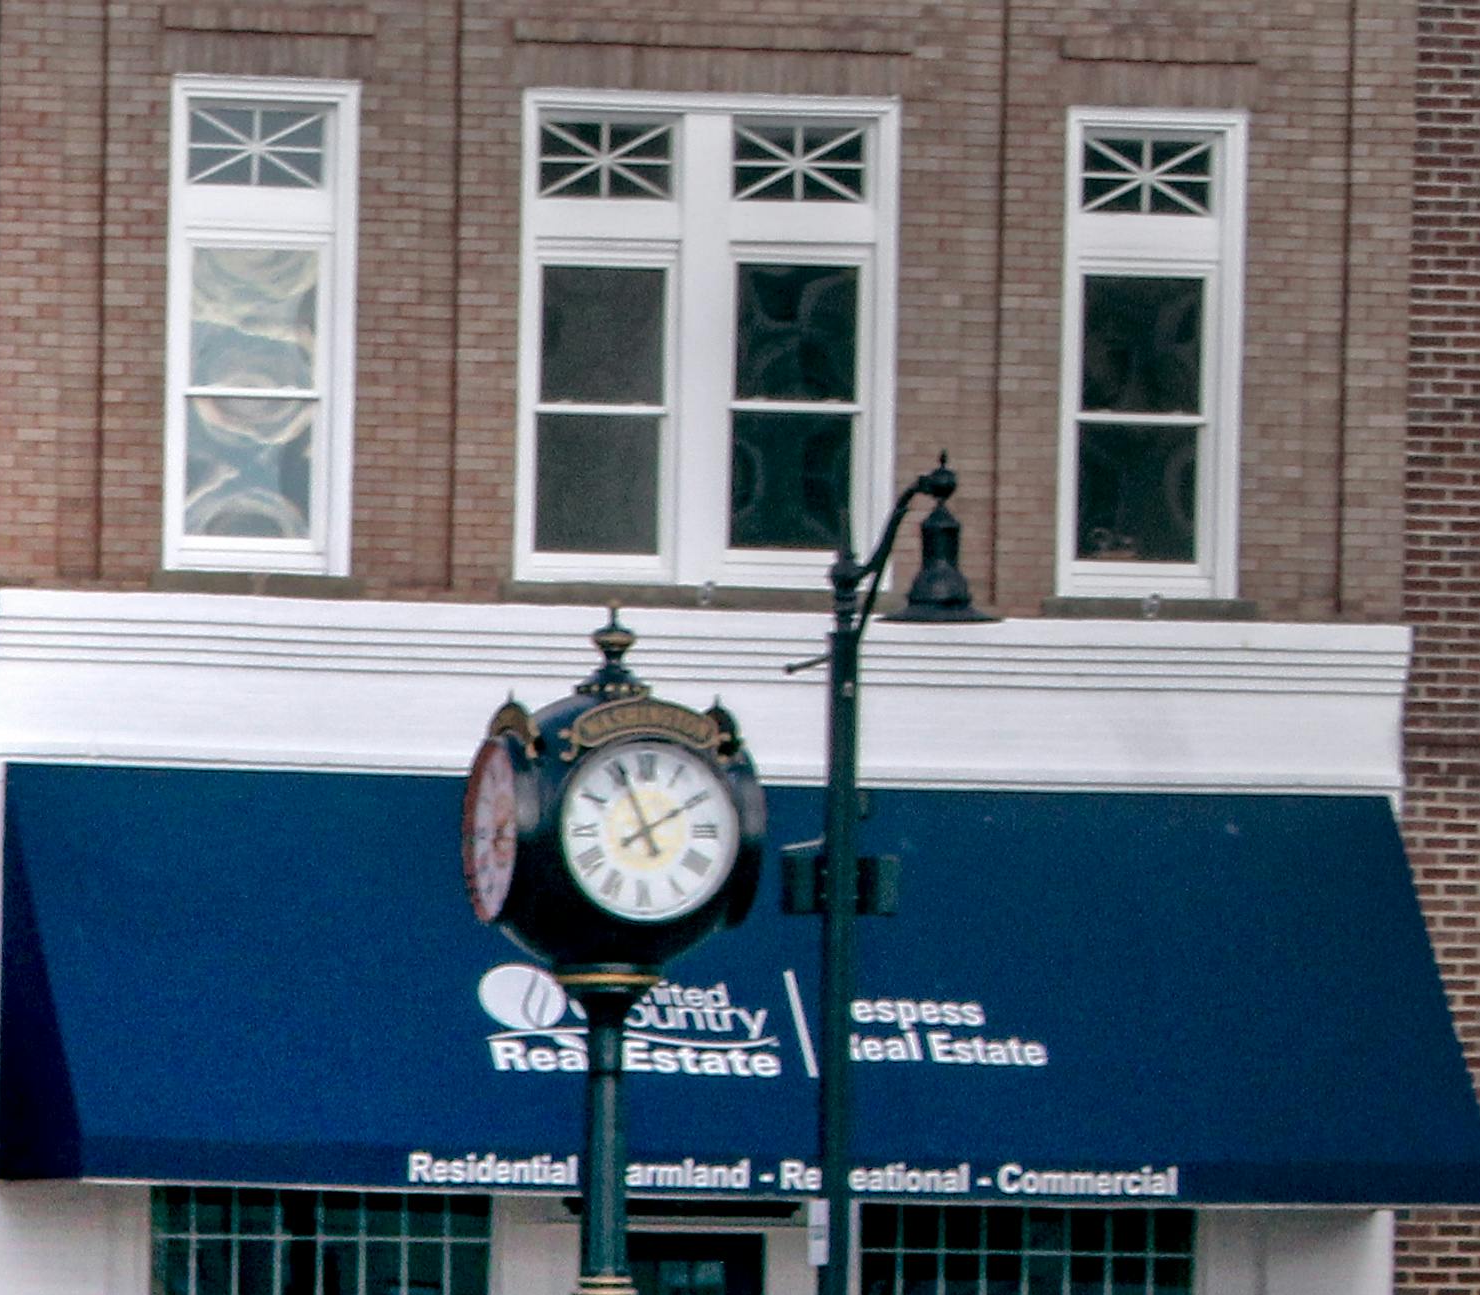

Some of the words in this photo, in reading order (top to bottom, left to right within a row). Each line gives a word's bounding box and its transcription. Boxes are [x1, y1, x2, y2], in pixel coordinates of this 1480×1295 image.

[623, 1006, 768, 1039] ountry
[850, 999, 985, 1031] espess
[489, 1039, 590, 1071] Rea
[622, 1040, 781, 1077] Estate
[926, 1030, 1049, 1067] Estate
[407, 1151, 579, 1186] Residential
[625, 1157, 752, 1189] armland
[780, 1159, 971, 1193] Reeational
[997, 1163, 1179, 1197] Commercial
